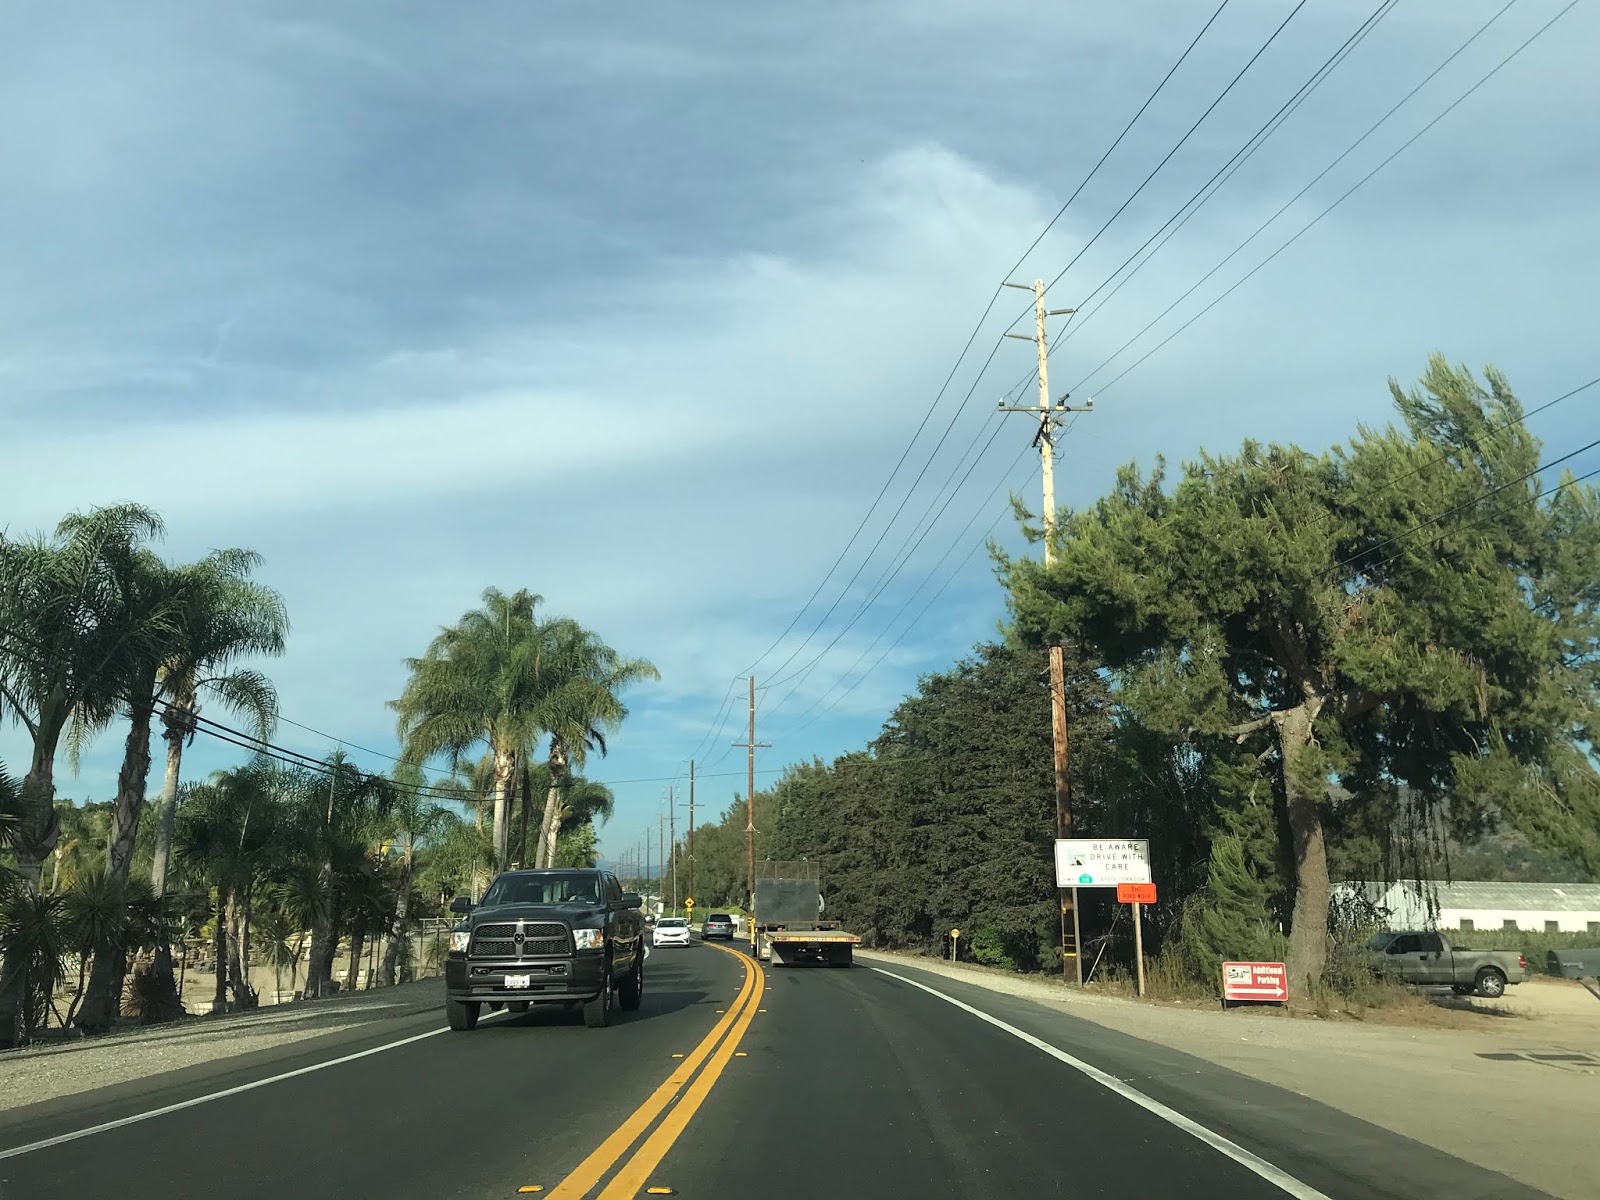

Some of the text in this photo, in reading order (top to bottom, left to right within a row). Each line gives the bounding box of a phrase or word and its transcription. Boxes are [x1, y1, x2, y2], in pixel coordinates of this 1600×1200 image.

[1093, 843, 1140, 851] BE AWARE
[1090, 853, 1144, 861] DRIVE WITH
[1253, 966, 1282, 974] Additional
[1257, 976, 1279, 985] Parking
